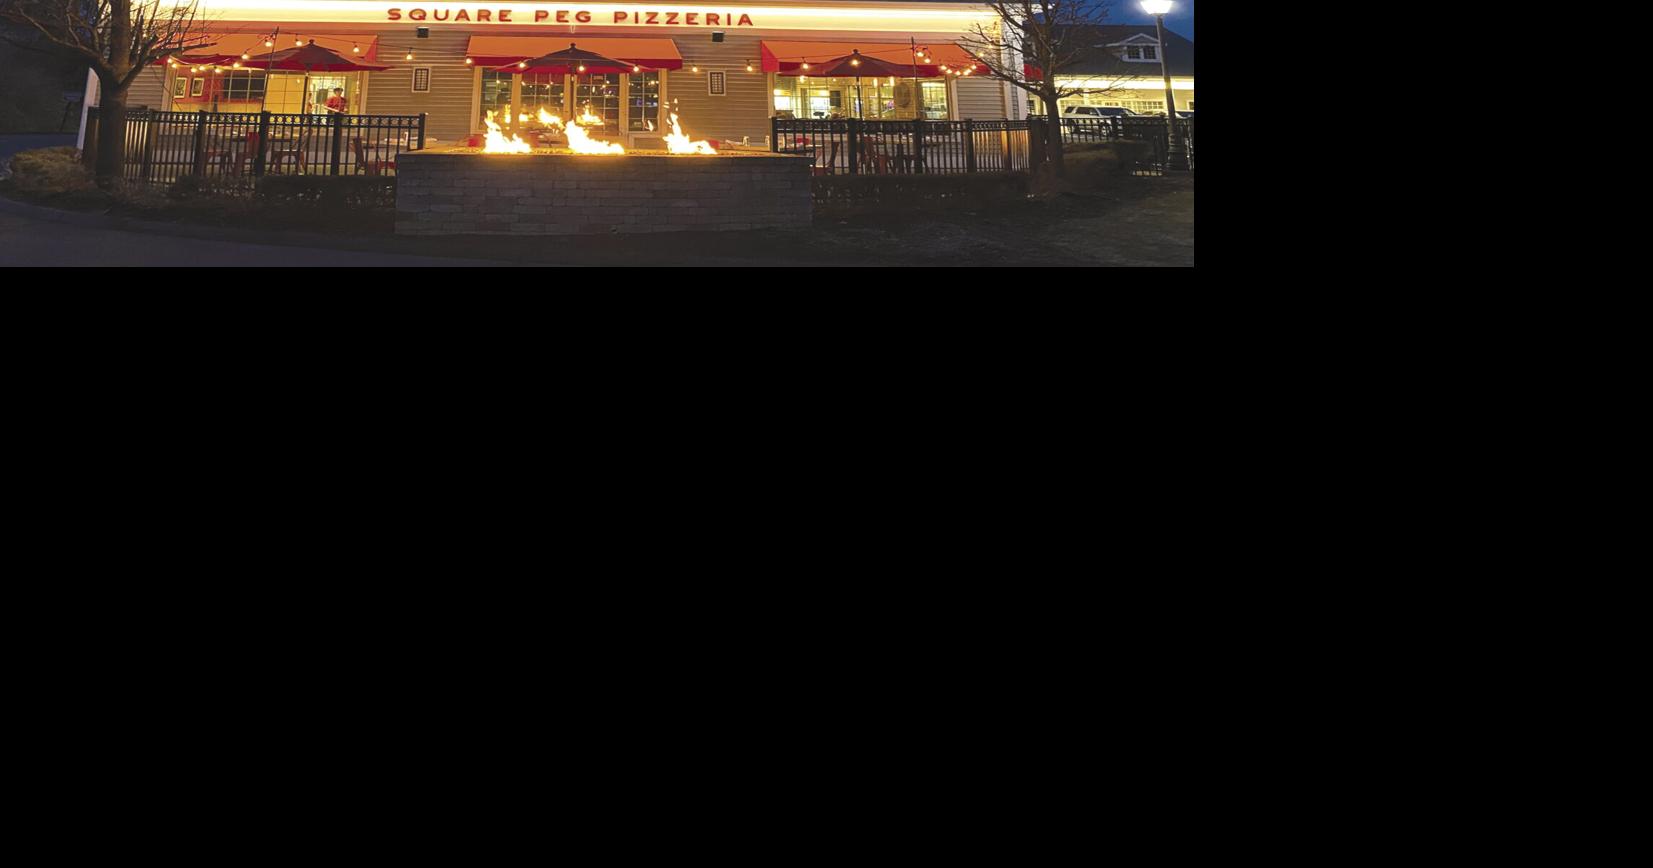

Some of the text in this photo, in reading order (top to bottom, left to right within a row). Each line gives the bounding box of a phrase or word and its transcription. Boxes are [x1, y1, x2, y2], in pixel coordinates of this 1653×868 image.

[387, 8, 754, 26] SQUARE PEG PIZZERIA
